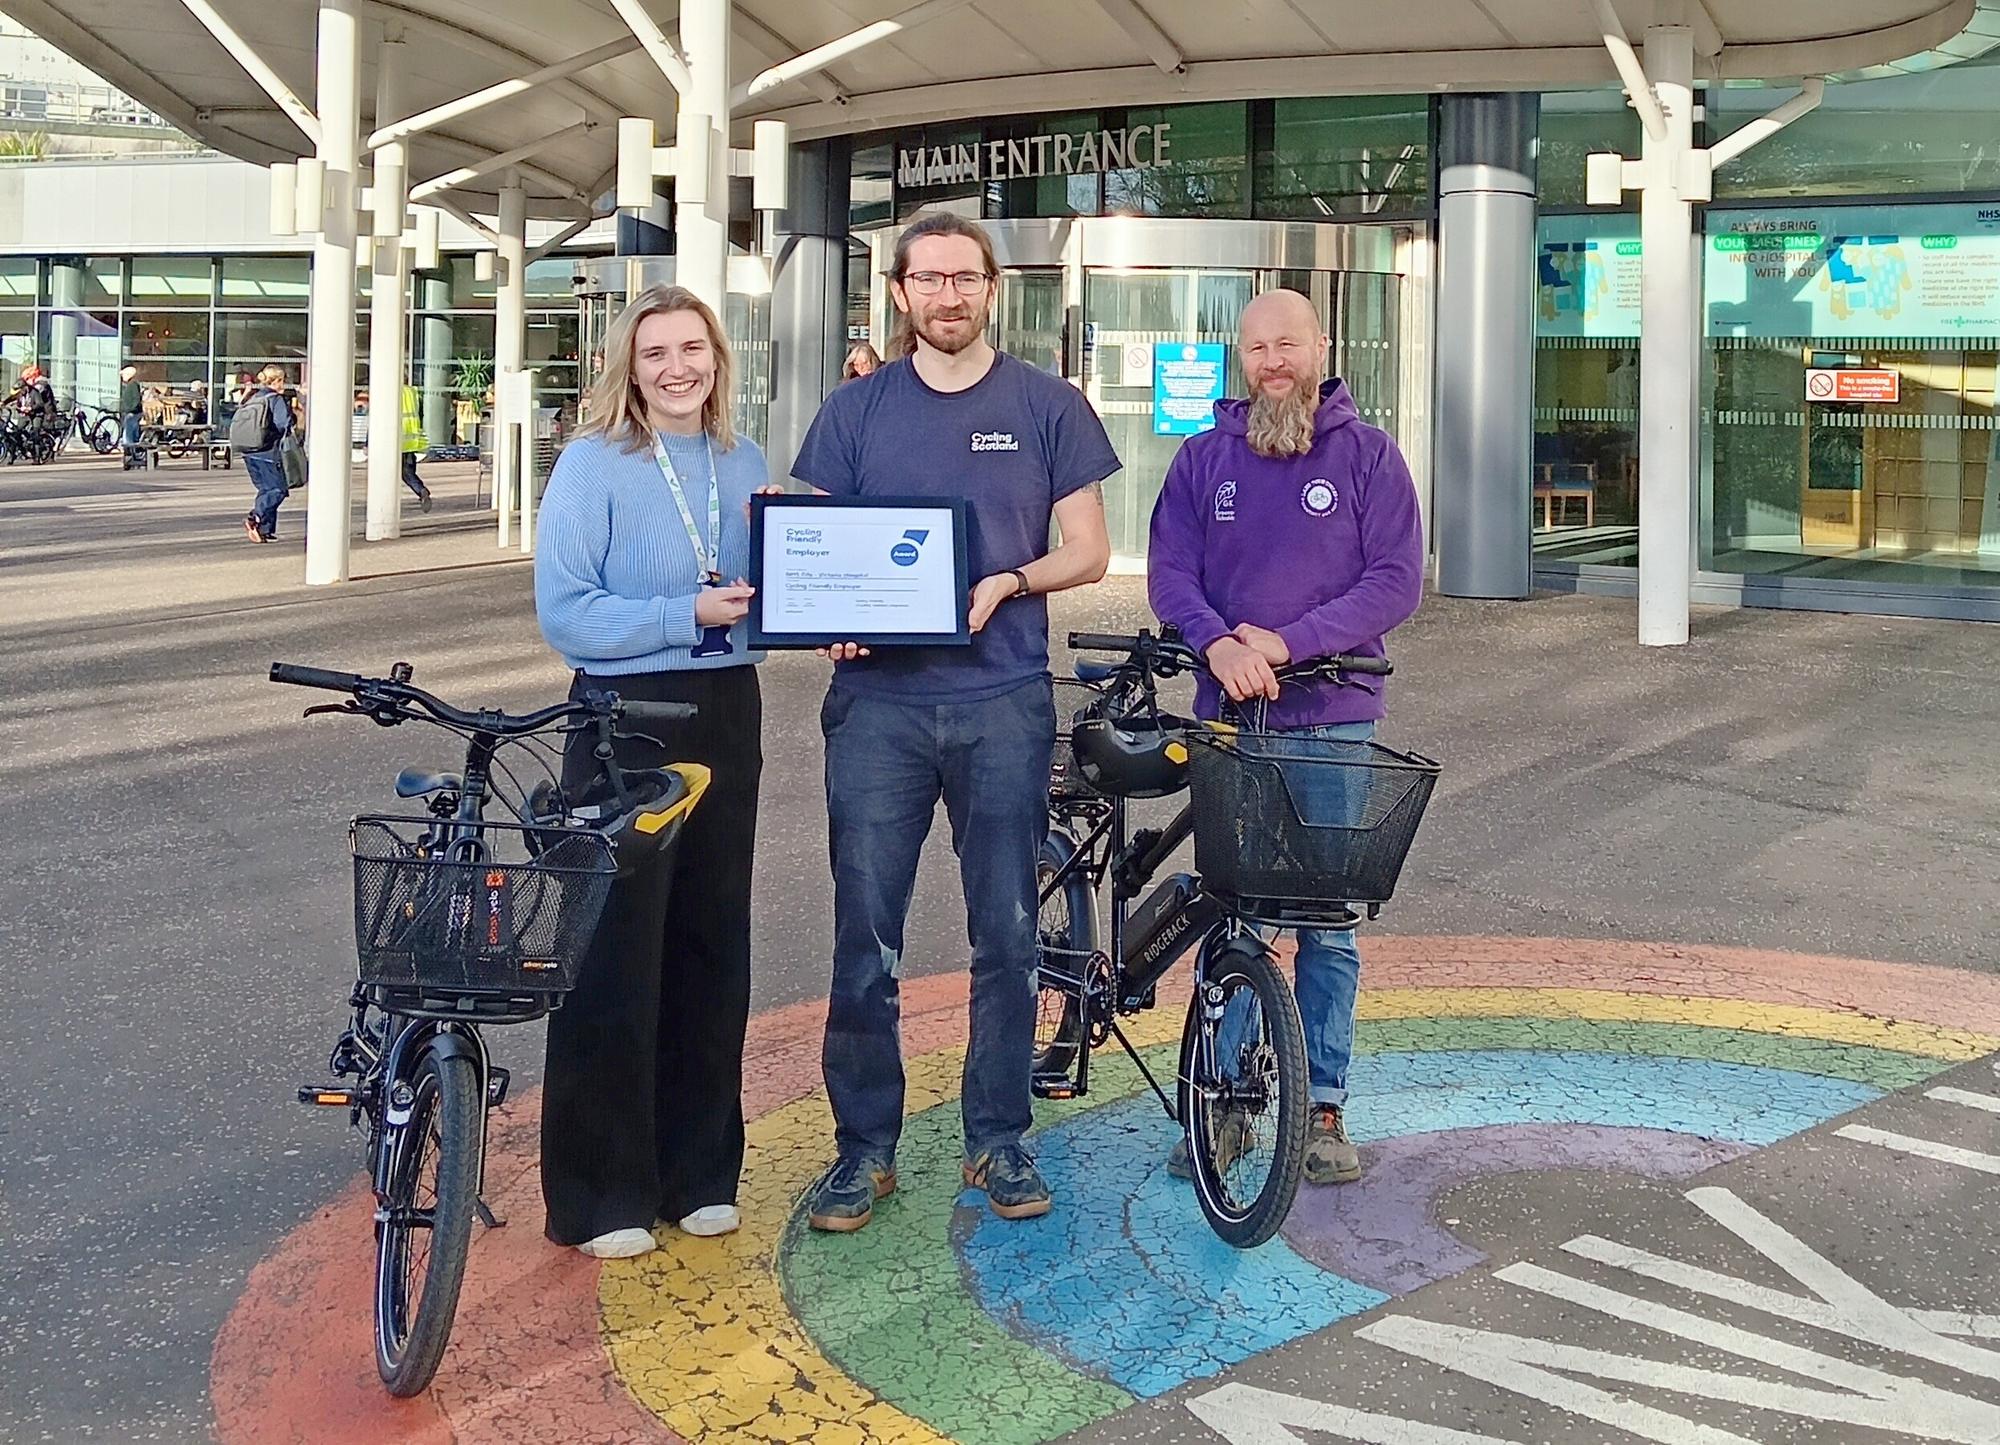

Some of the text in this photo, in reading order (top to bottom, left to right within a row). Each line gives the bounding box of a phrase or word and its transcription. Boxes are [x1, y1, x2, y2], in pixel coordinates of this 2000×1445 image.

[899, 123, 1172, 188] MAIN ENTRANCE
[1978, 209, 2000, 218] NHS
[1731, 220, 1816, 232] ALWAYS BRING
[1716, 236, 1817, 249] YOUR MEDICINES
[1923, 236, 1957, 248] WHY?
[1730, 252, 1816, 263] INTO HOSPITAL
[1755, 267, 1816, 278] WITH YOU
[1843, 376, 1891, 386] No smoking
[971, 431, 1012, 444] Cycling
[971, 440, 1019, 451] Scotland
[786, 528, 822, 537] Cycling
[786, 536, 822, 544] Friendly
[786, 548, 831, 557] Employer
[1143, 913, 1191, 963] RIDGEBACK
